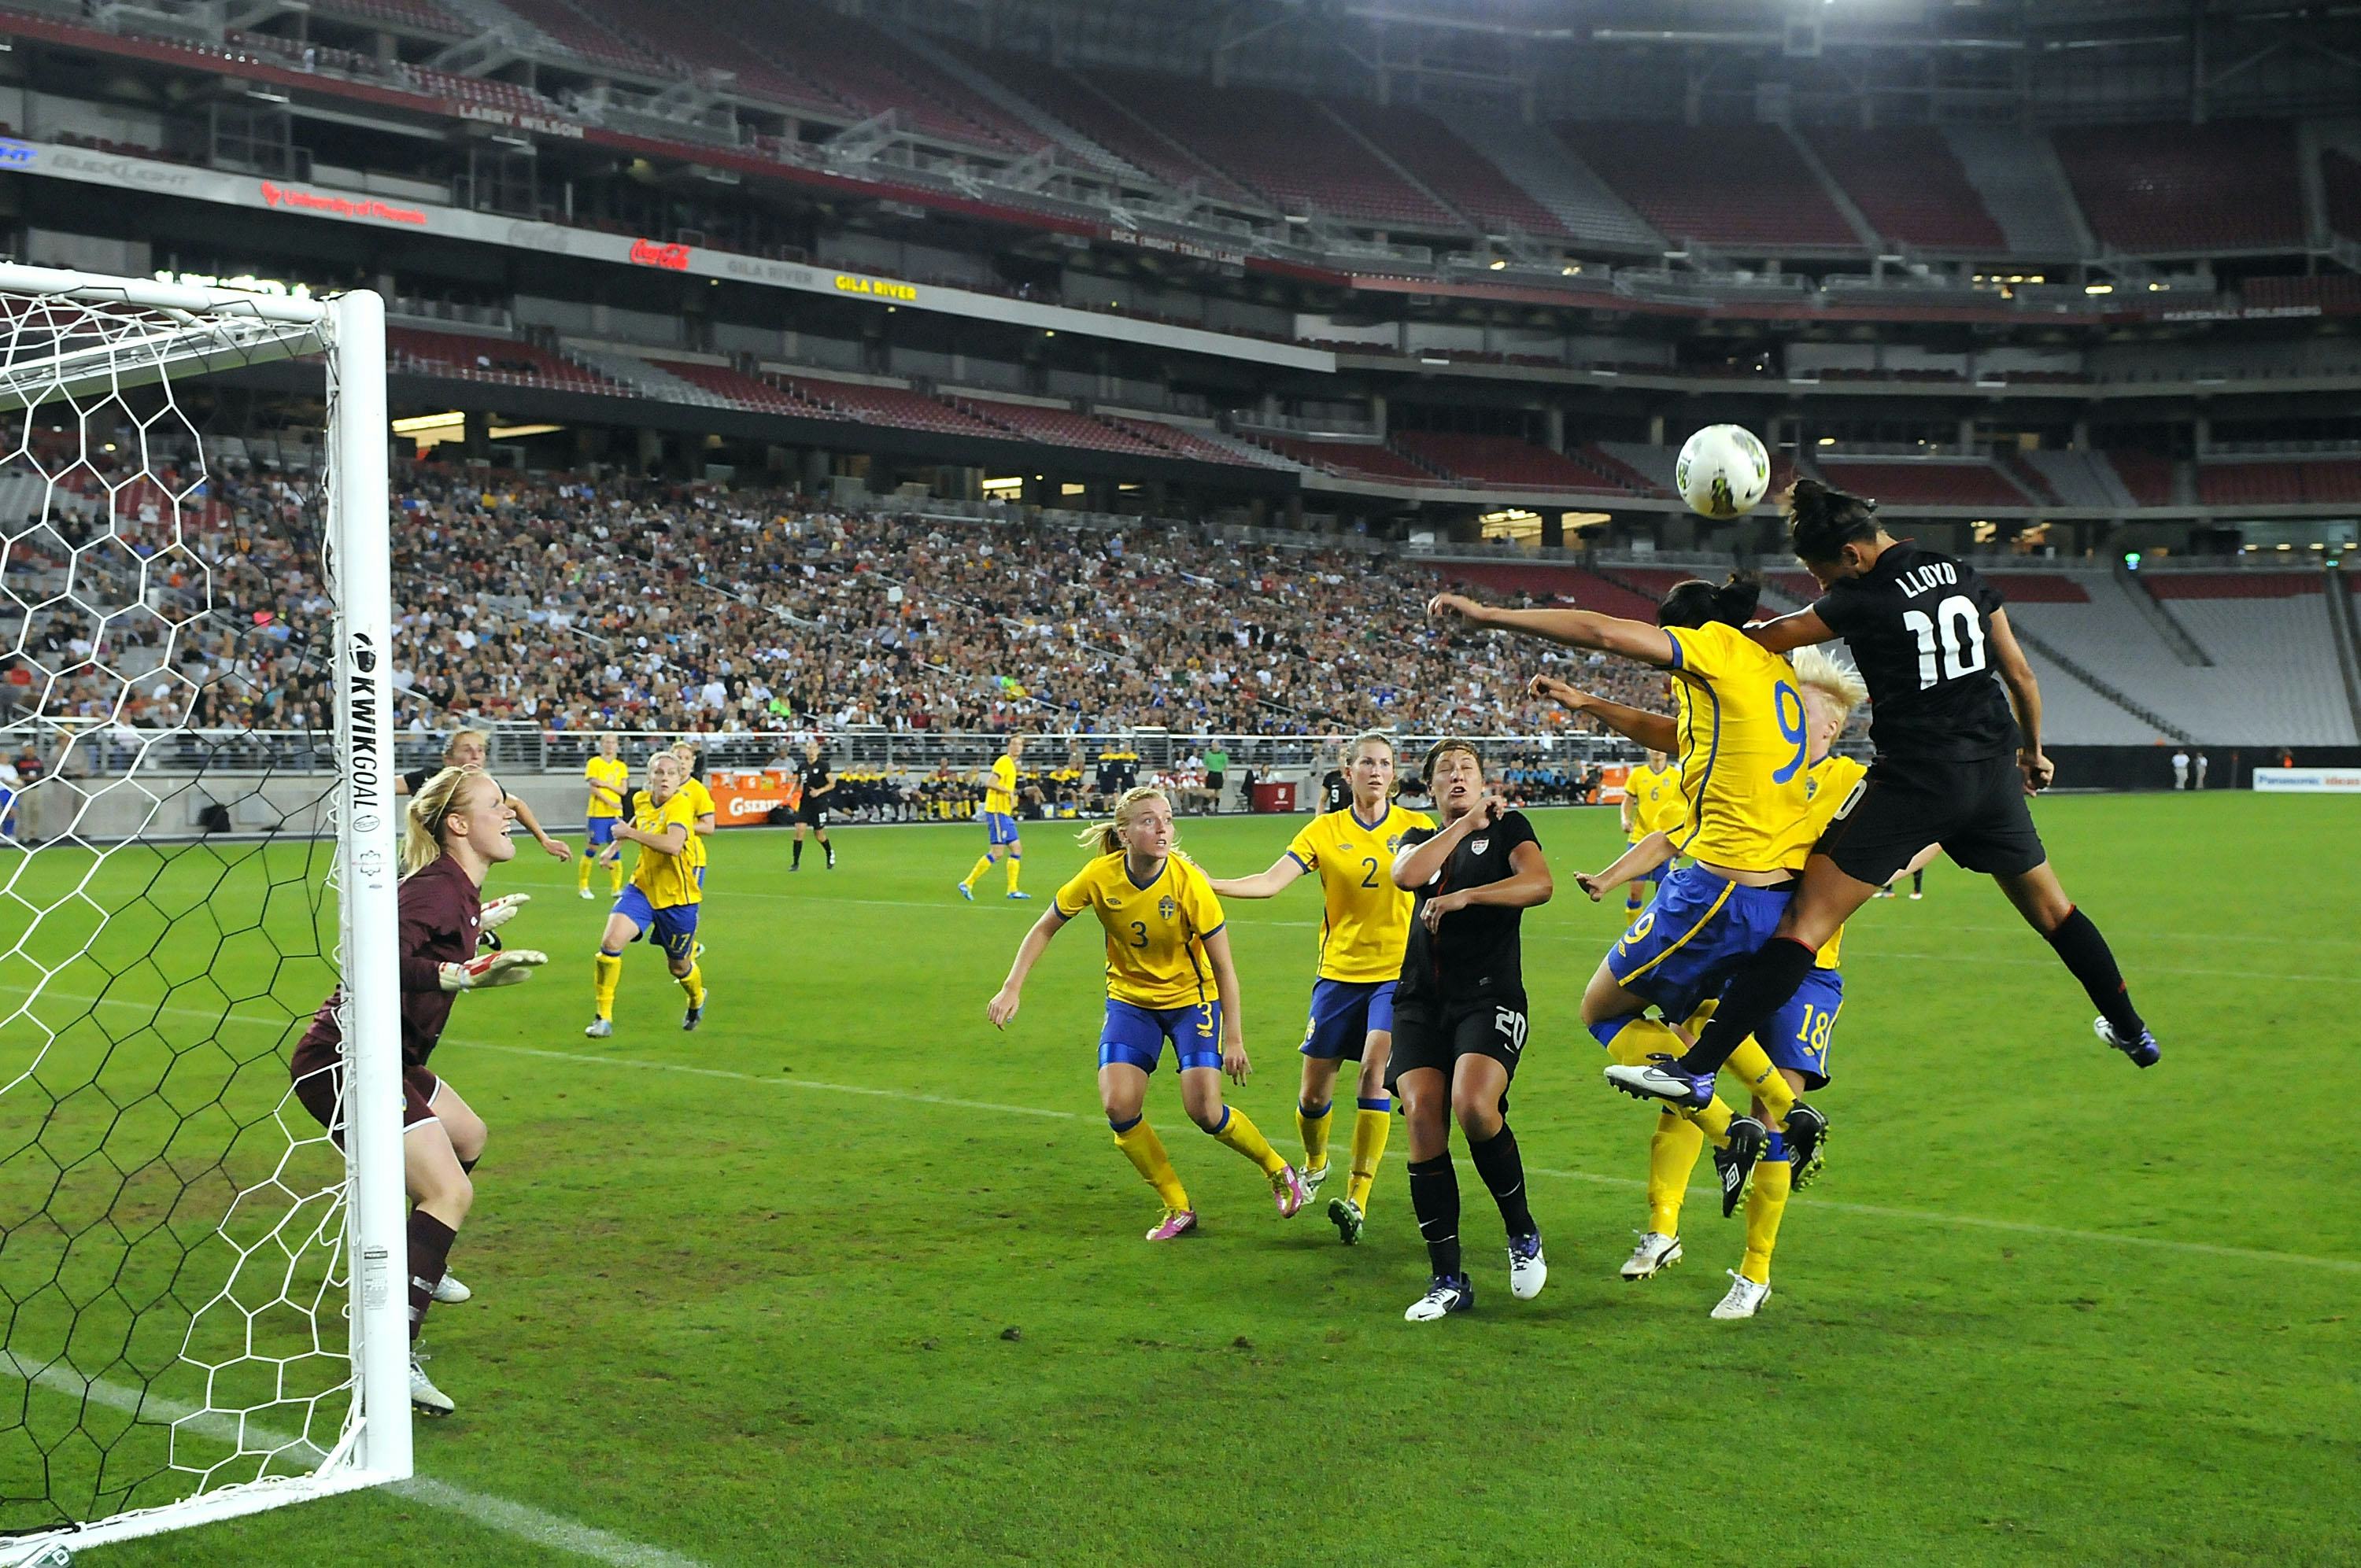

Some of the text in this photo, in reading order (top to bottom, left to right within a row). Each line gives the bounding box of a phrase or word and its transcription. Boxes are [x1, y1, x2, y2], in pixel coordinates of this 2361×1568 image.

[284, 189, 427, 225] University of Phoenix
[835, 275, 916, 301] GILA RIVER
[1894, 562, 1957, 599] LLOYD
[1902, 595, 1986, 691] 10
[1772, 679, 1808, 784] 9
[1650, 786, 1659, 801] 6
[2258, 774, 2320, 785] Panasonic
[729, 797, 745, 817] G
[1331, 788, 1339, 803] 9
[1361, 858, 1379, 887] 2
[671, 933, 691, 950] 17
[1130, 921, 1149, 948] 3
[1624, 913, 1656, 944] 9
[1196, 1001, 1214, 1031] 3
[1495, 1005, 1527, 1050] 20
[1796, 1003, 1829, 1050] 18
